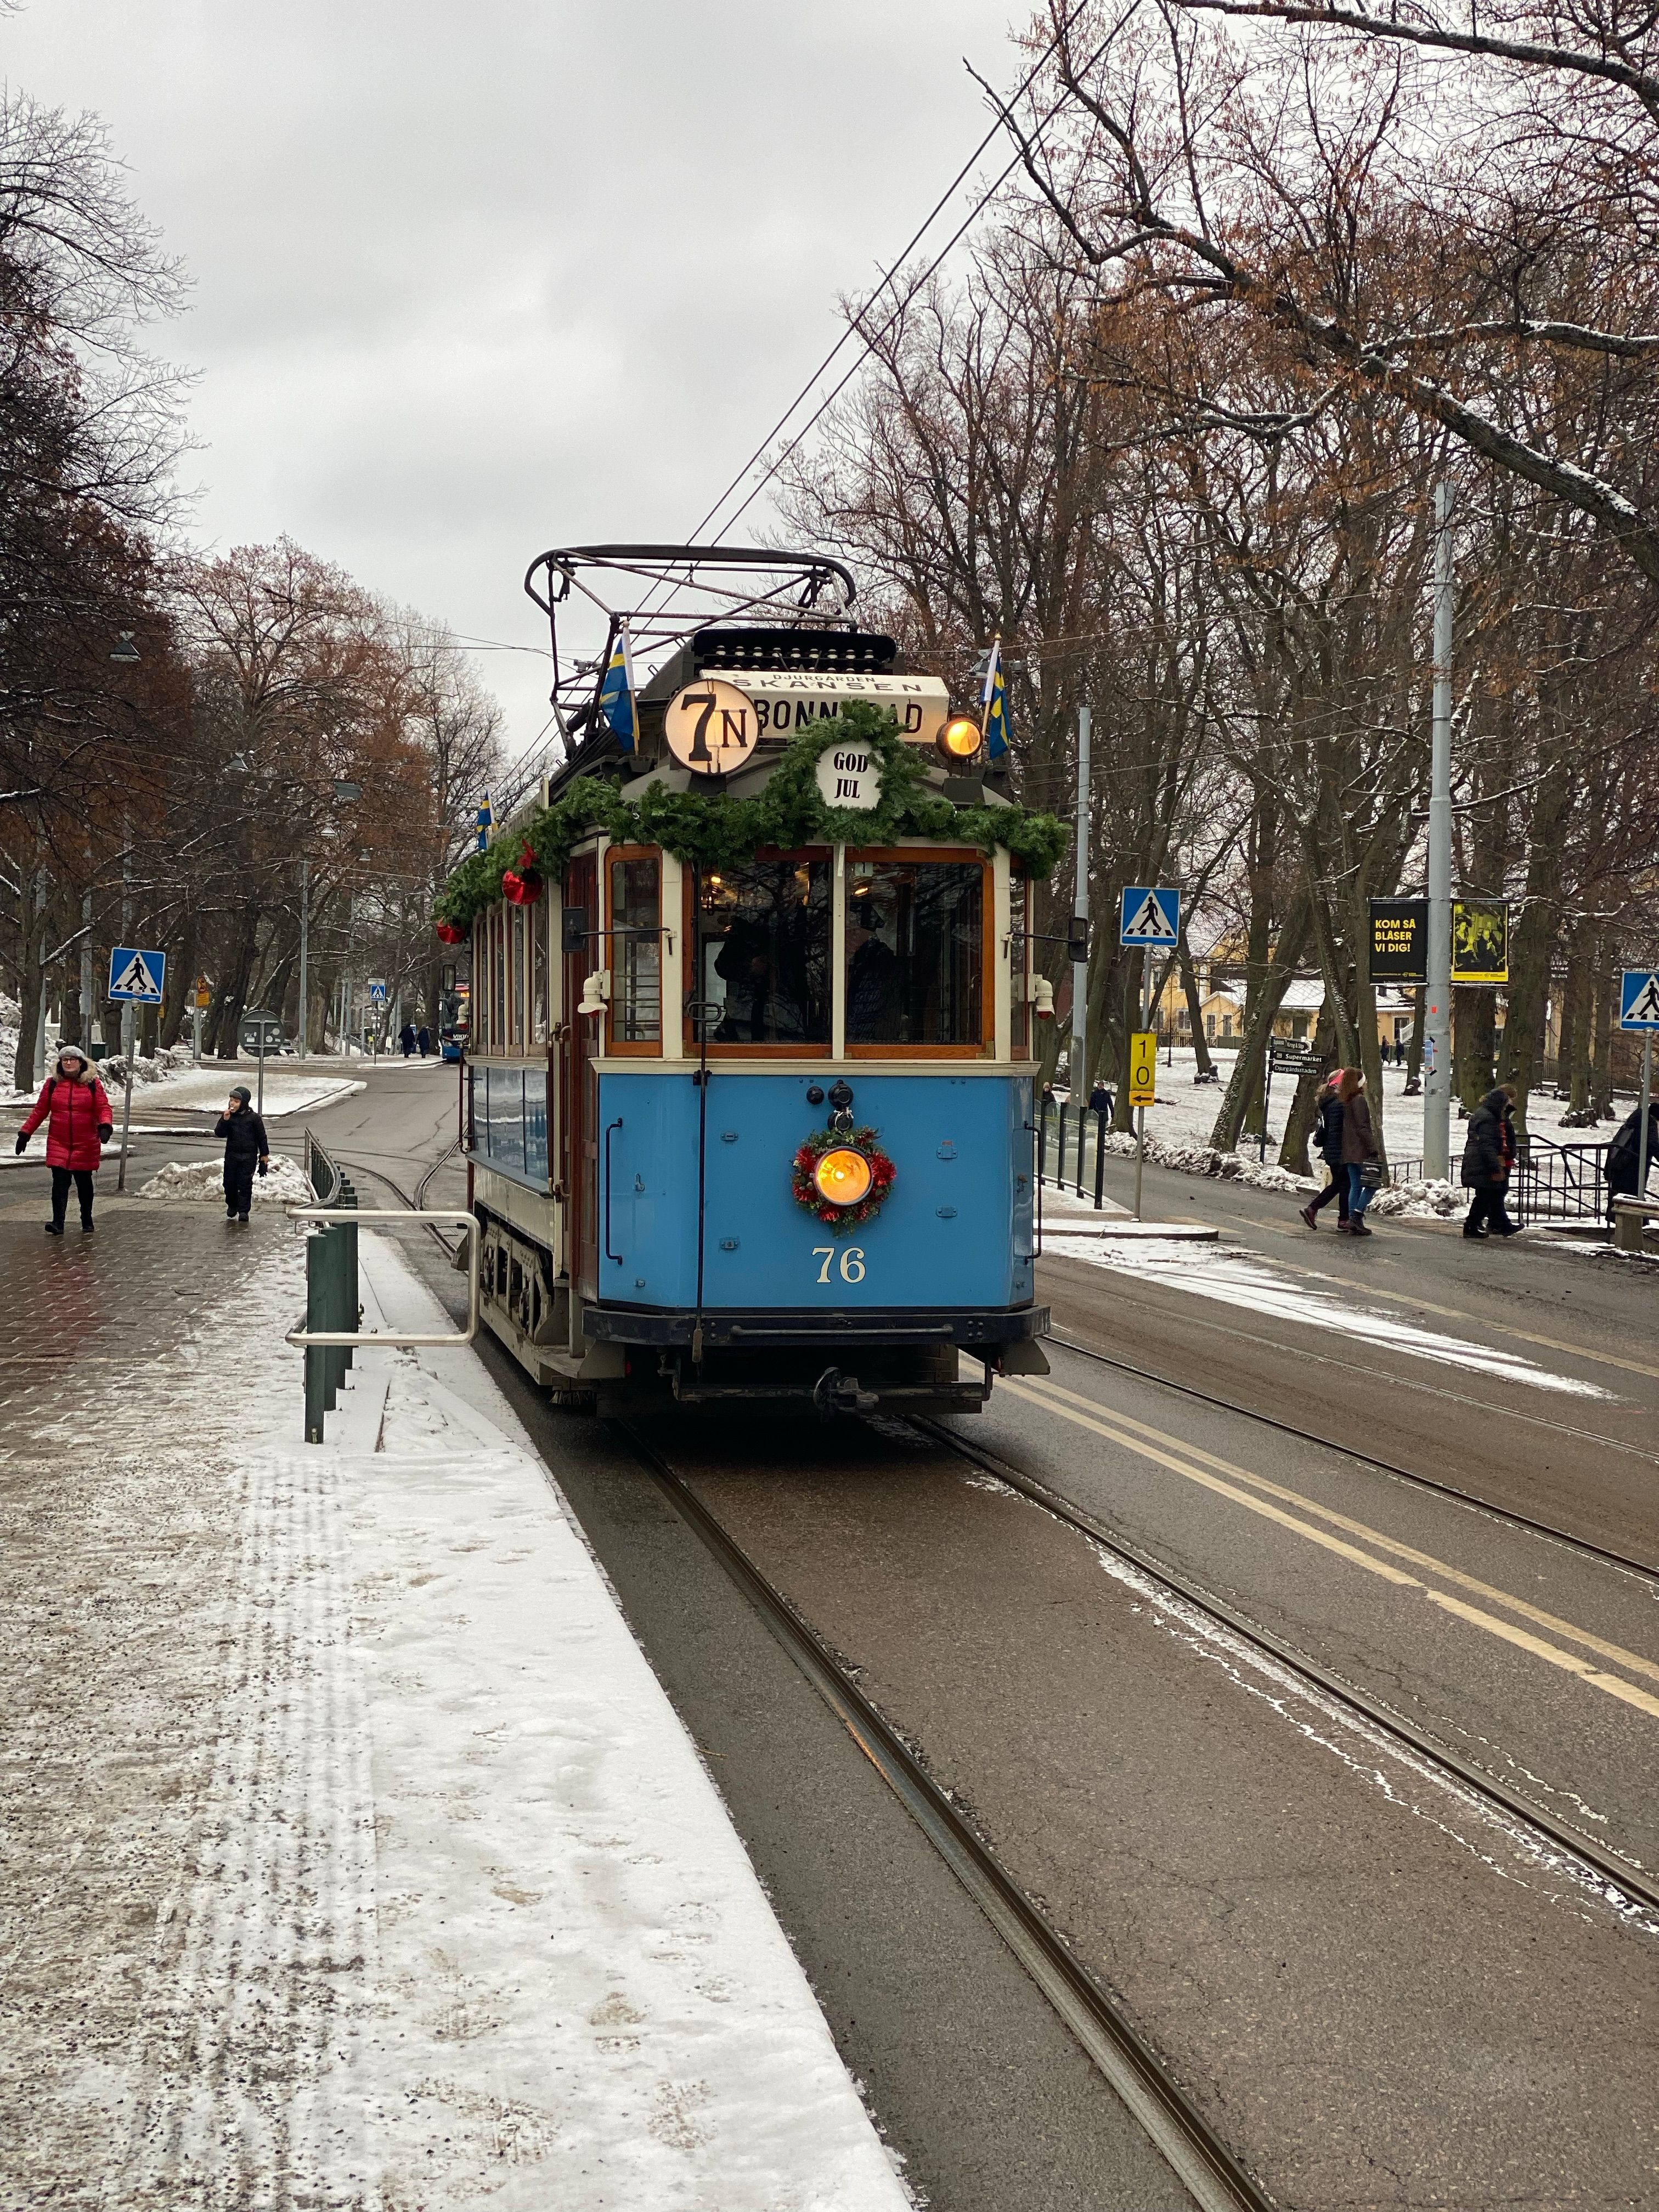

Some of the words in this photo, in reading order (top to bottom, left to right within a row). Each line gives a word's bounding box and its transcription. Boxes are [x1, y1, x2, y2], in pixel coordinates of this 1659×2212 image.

[772, 674, 876, 682] DJURGÅRDEN
[733, 679, 922, 692] SKANSEN
[680, 693, 748, 761] 7N
[833, 752, 868, 773] GOD
[834, 778, 861, 799] JUL
[1375, 919, 1400, 929] KOM
[1403, 918, 1416, 929] SÅ
[1375, 930, 1412, 940] BLÅSER
[1375, 943, 1385, 952] VI
[1388, 943, 1410, 952] DIG!
[1285, 1053, 1322, 1062] Supermarket
[1275, 1065, 1317, 1074] Djurgårdsstaden
[811, 1246, 866, 1284] 76
